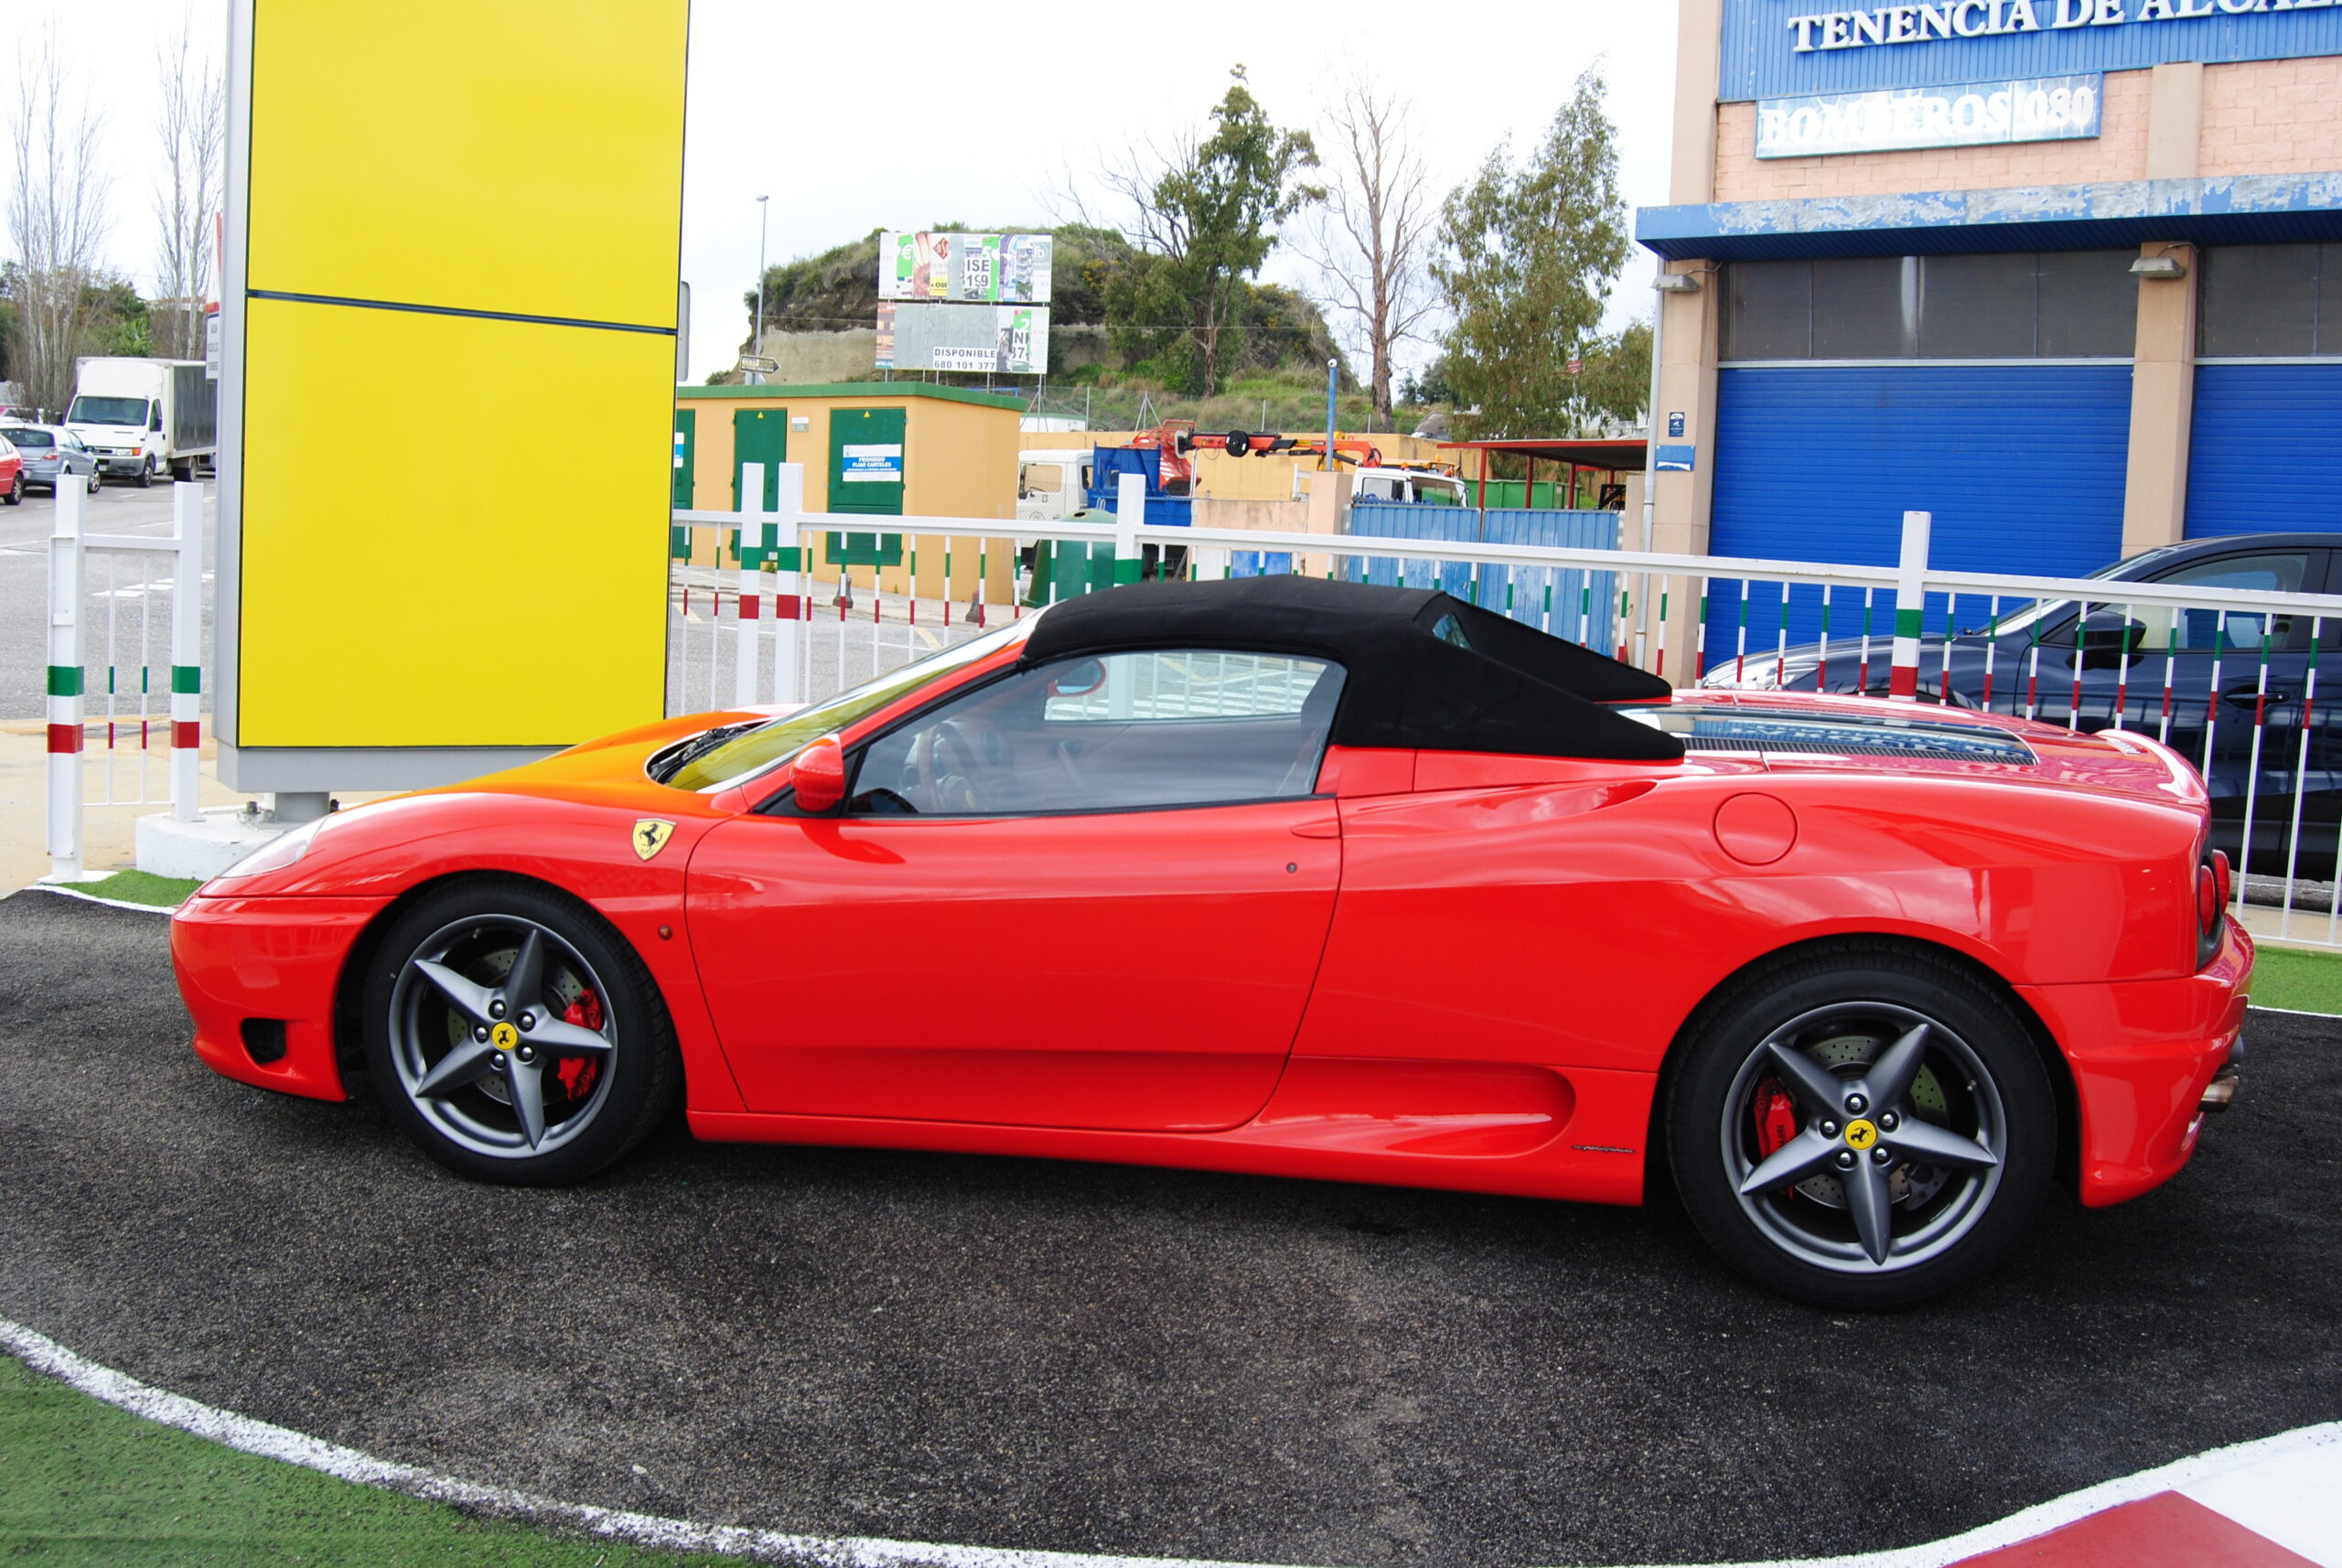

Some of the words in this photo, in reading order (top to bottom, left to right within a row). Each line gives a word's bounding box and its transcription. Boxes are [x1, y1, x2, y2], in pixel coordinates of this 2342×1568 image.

[1787, 0, 2041, 52] TENENCIA
[2052, 0, 2126, 28] DE
[2024, 86, 2094, 127] 080
[934, 349, 996, 358] DISPONIBLE
[934, 360, 952, 369] 680
[978, 362, 995, 371] 377
